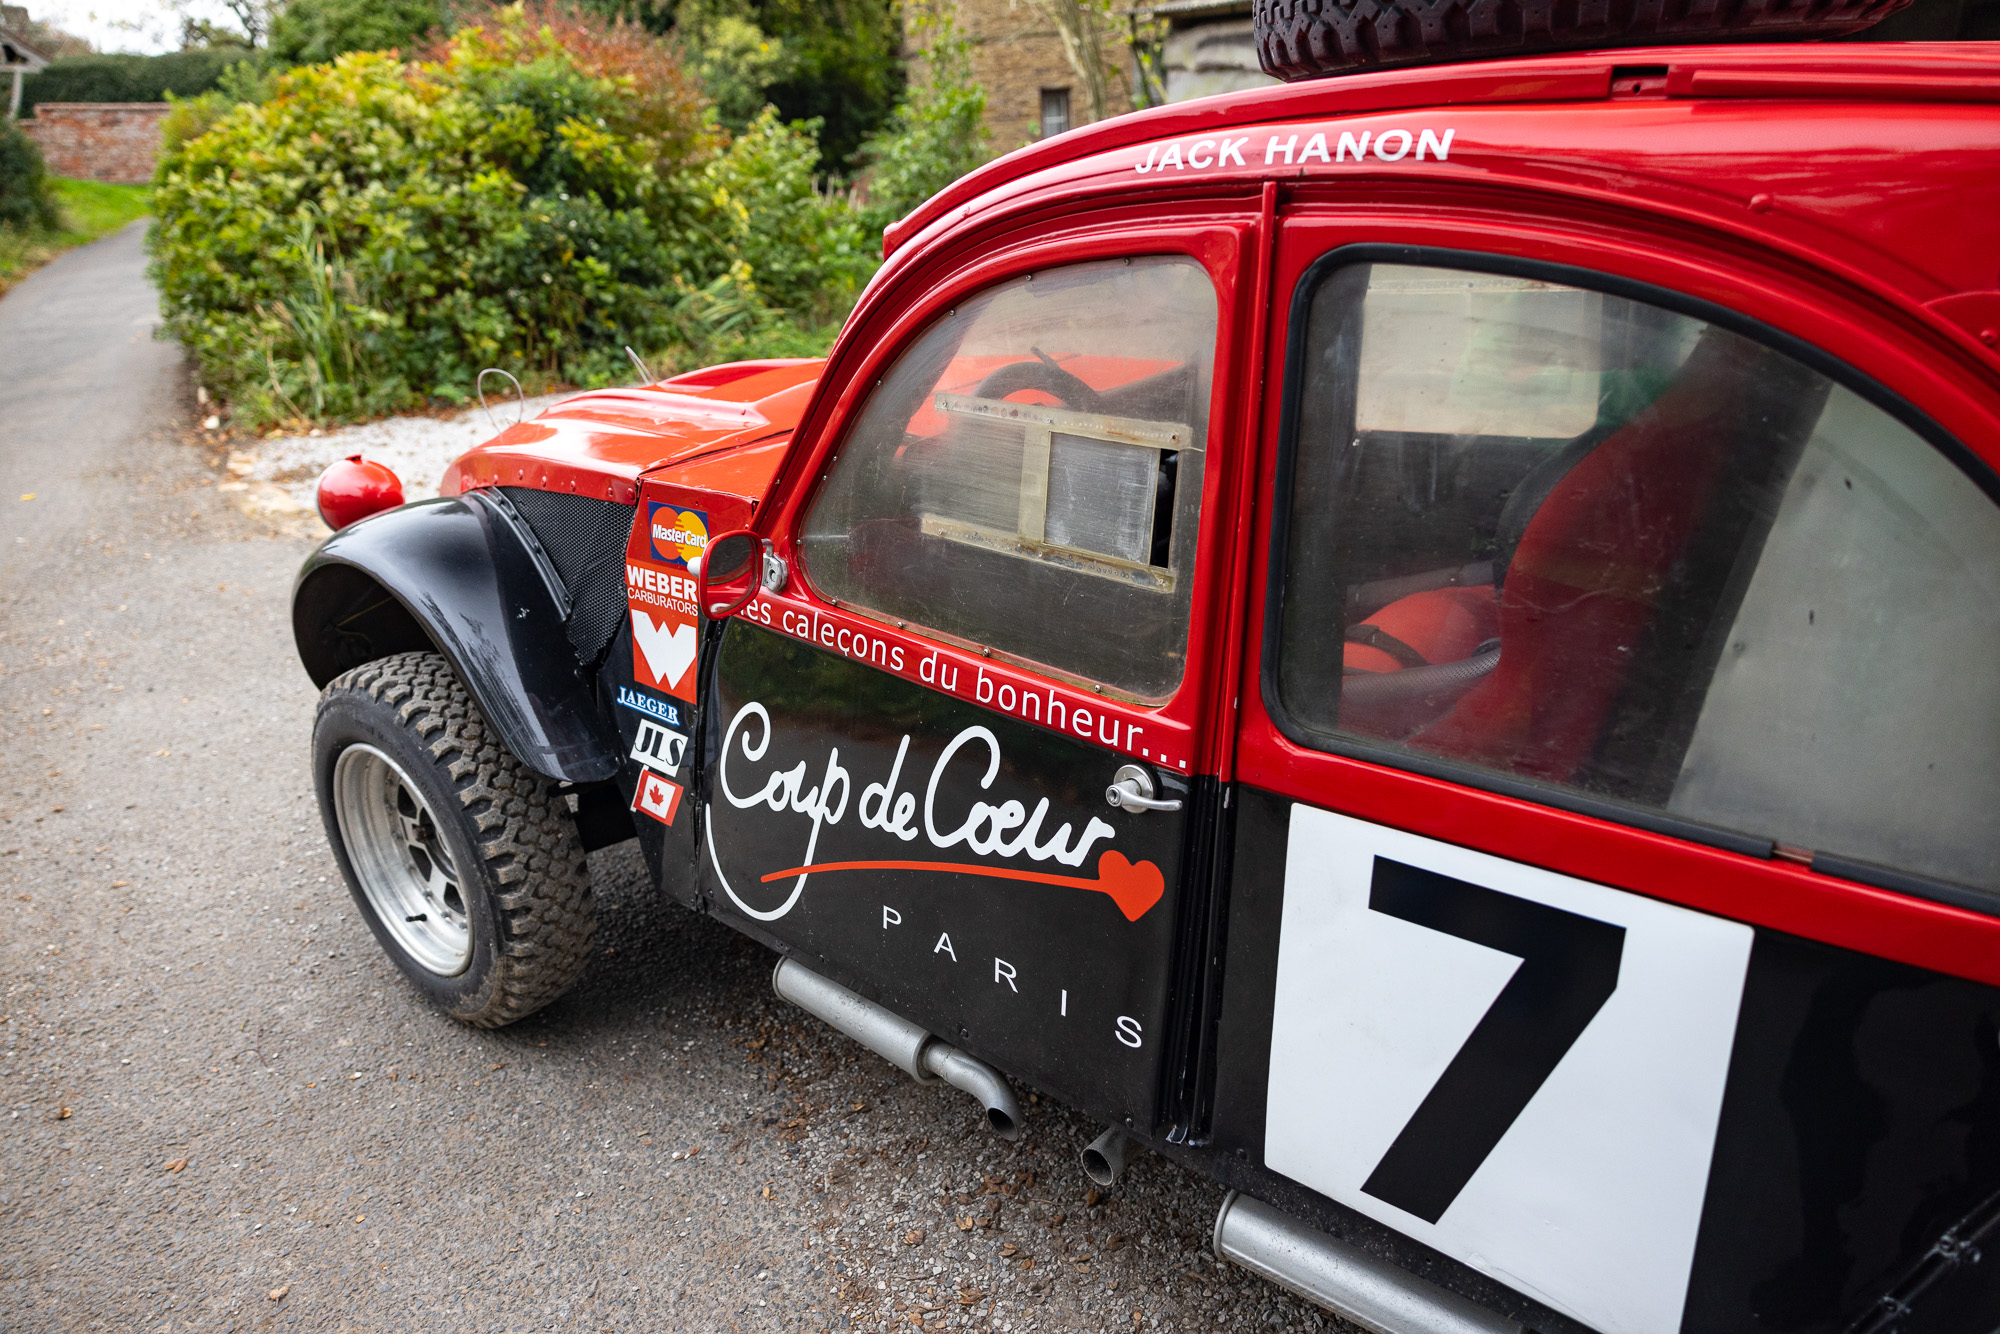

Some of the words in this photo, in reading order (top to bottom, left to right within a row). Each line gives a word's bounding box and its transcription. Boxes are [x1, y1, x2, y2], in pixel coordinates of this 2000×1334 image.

[1135, 137, 1249, 174] JACK
[1264, 129, 1456, 165] HANON
[652, 523, 707, 548] MasterCard
[626, 564, 698, 602] WEBER
[627, 587, 698, 616] CARBURATORS
[740, 599, 772, 626] es
[782, 613, 904, 671] caleçons
[919, 652, 957, 691] du
[976, 667, 1187, 768] bonheur...
[617, 686, 680, 726] JAEGER
[634, 726, 684, 767] JLS
[706, 702, 850, 921] Coup
[859, 734, 918, 841] de
[882, 905, 1142, 1048] PARIS
[1360, 854, 1627, 1225] 7
